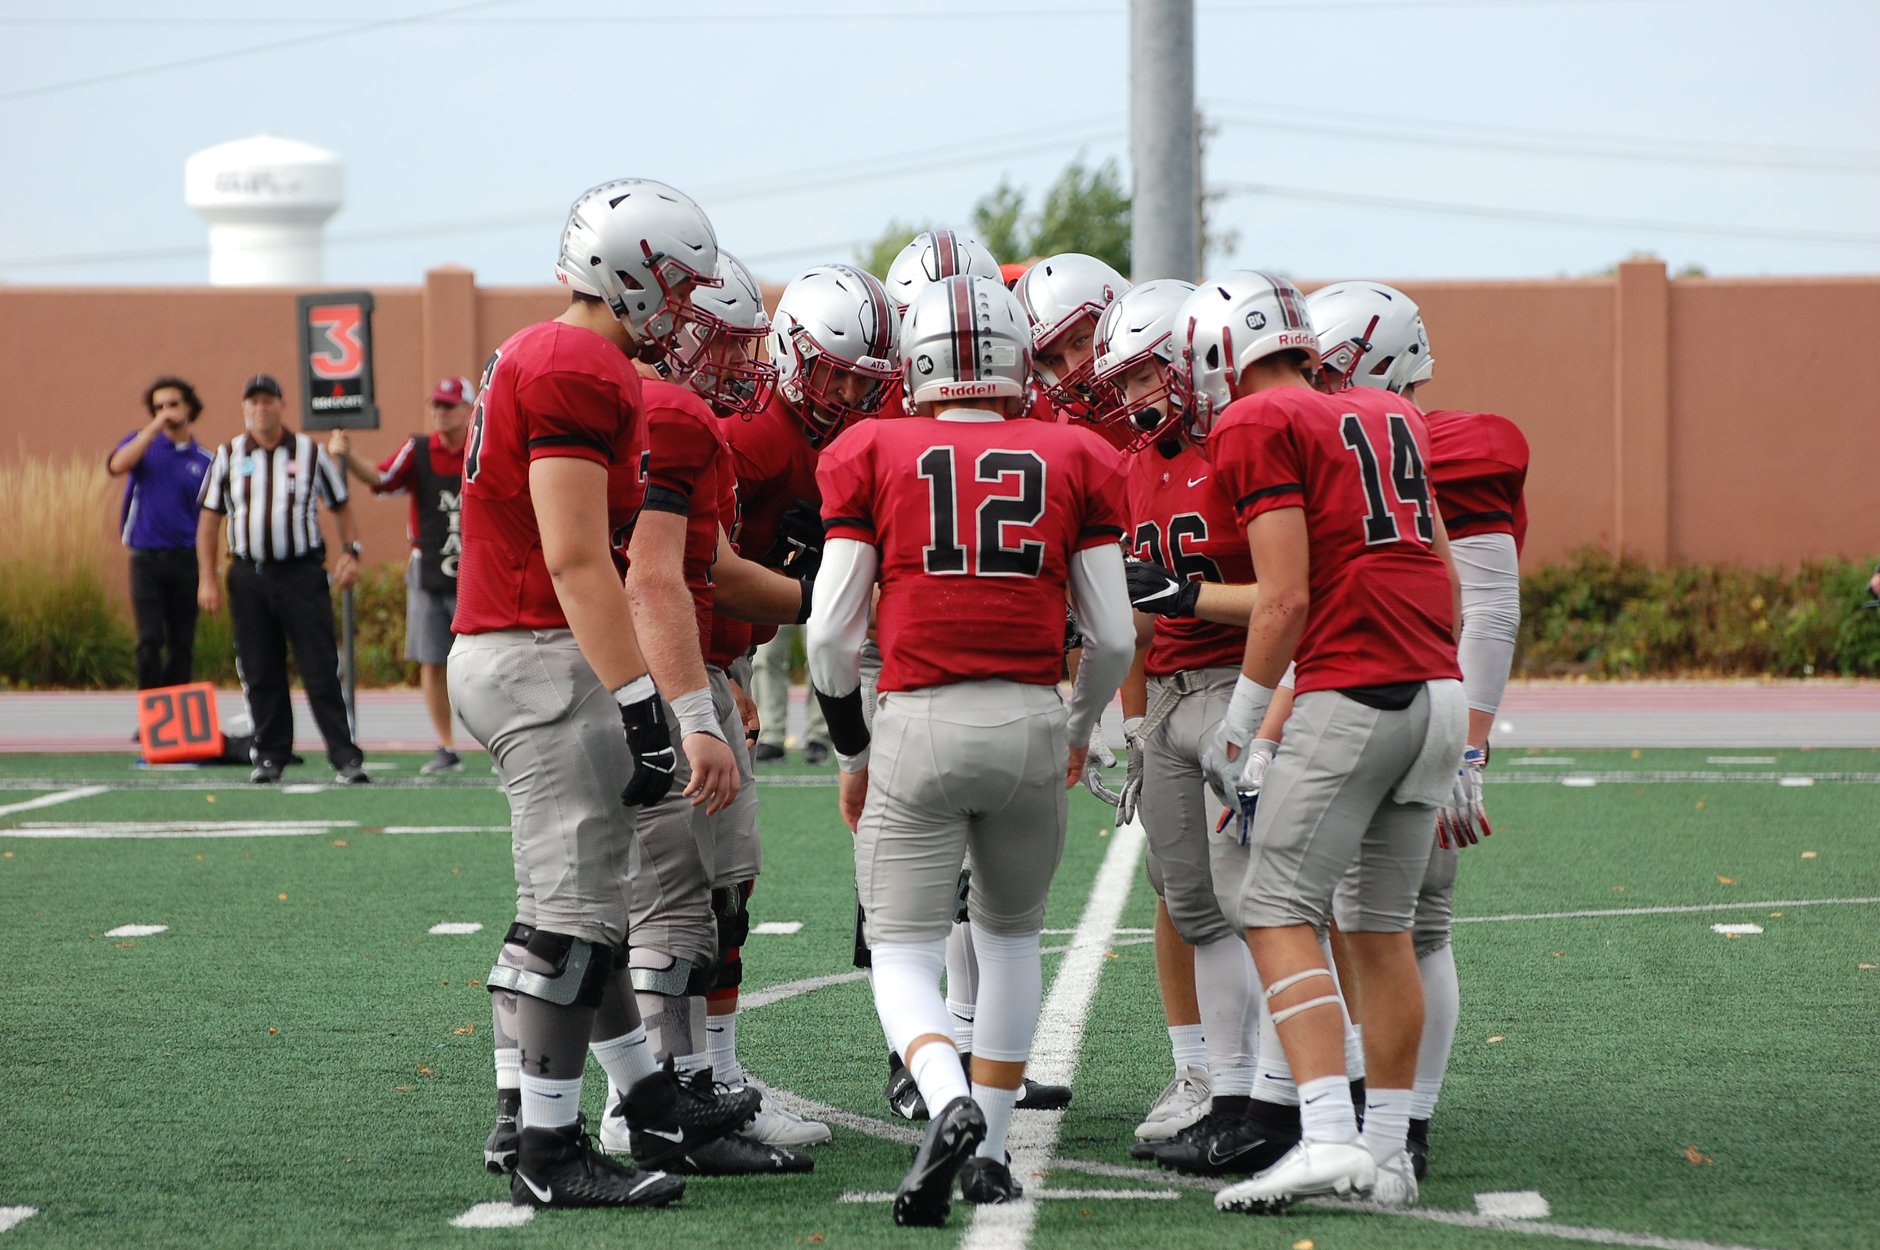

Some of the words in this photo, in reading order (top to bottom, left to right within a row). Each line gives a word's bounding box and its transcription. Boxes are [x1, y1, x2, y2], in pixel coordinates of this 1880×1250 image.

[1247, 312, 1265, 328] BK
[309, 303, 365, 379] 3
[1279, 333, 1316, 346] Ridde
[917, 356, 933, 373] BK
[940, 384, 997, 397] Riddell
[1339, 412, 1434, 546] 14
[916, 445, 1046, 578] 12
[146, 690, 211, 748] 20
